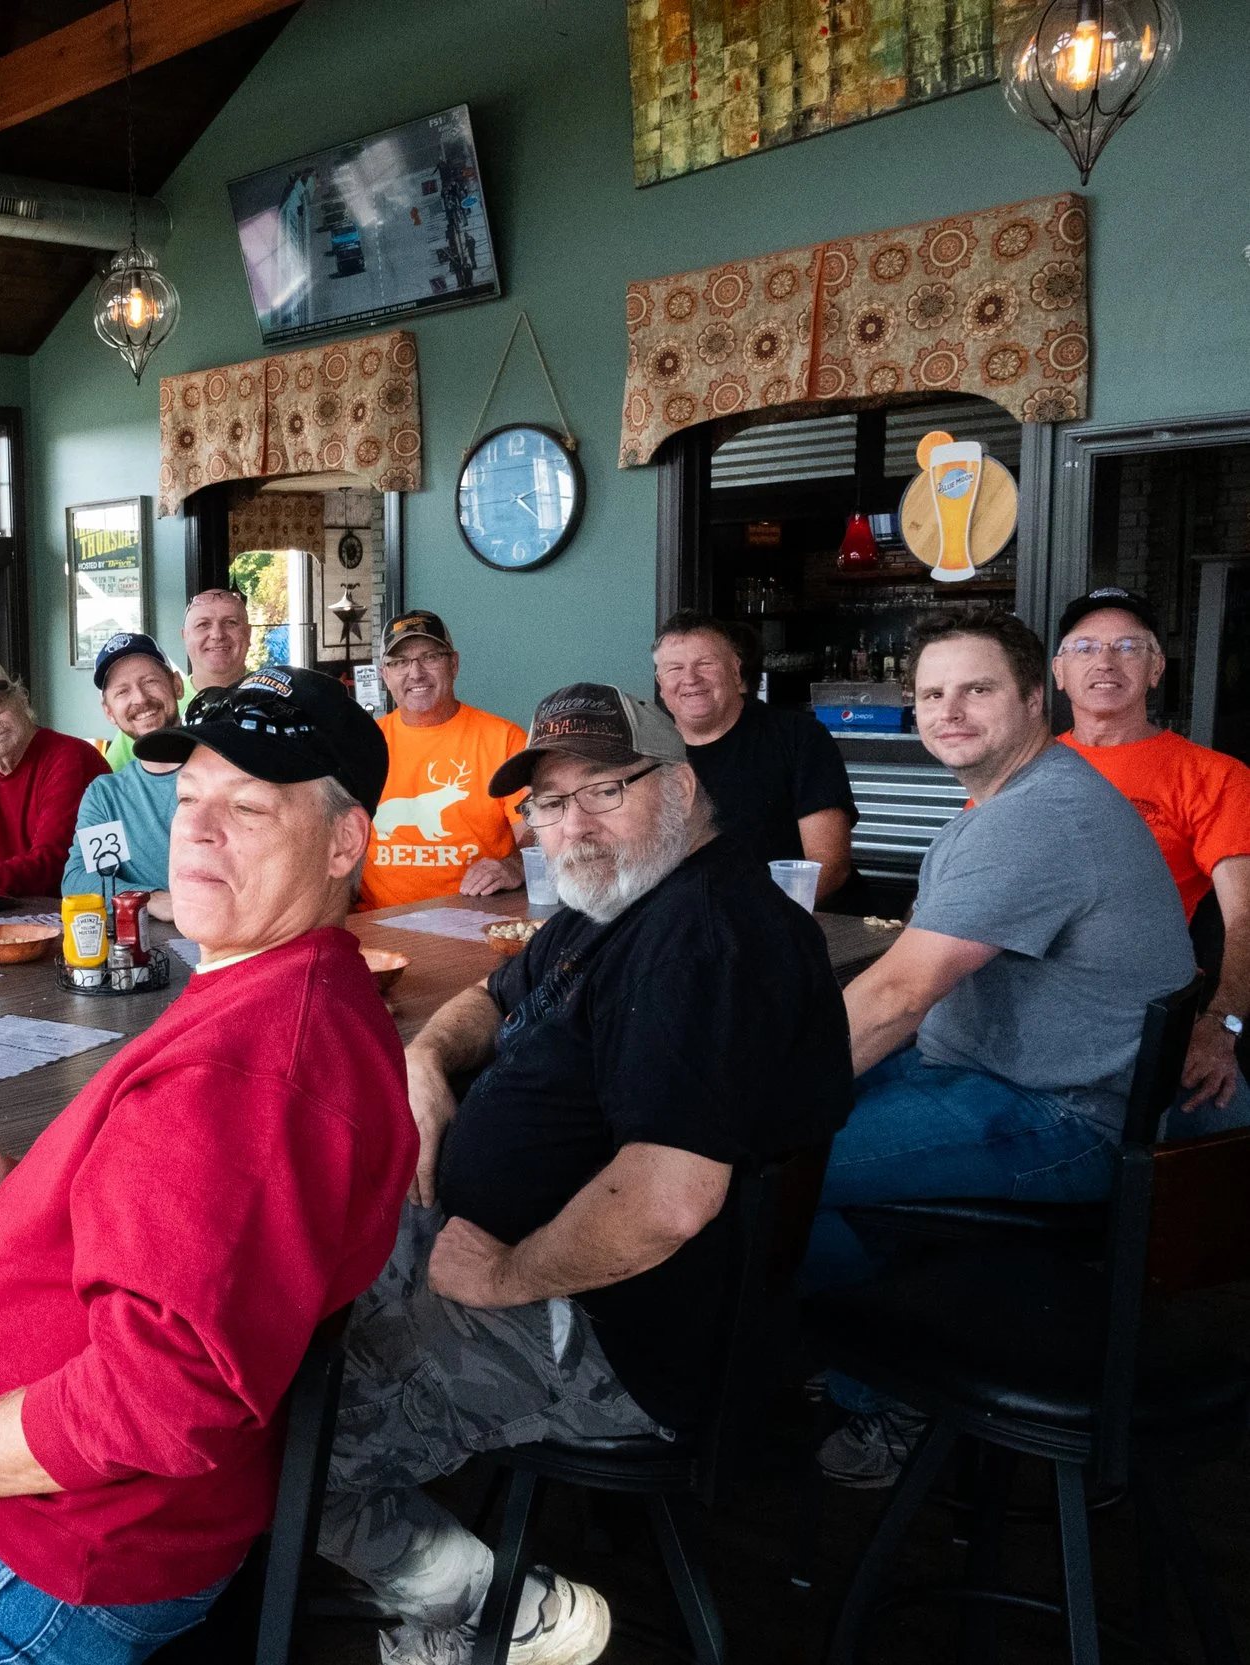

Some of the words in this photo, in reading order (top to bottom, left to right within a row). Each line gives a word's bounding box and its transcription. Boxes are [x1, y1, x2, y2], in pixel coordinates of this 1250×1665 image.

[486, 442, 498, 463] 11
[509, 434, 526, 456] 12
[938, 481, 956, 494] BLUE
[955, 473, 974, 485] MOON
[491, 540, 504, 558] 7
[512, 540, 526, 561] 6
[538, 533, 551, 553] 5
[78, 561, 97, 569] HOSTED
[89, 833, 121, 860] 23
[373, 844, 479, 866] BEER?
